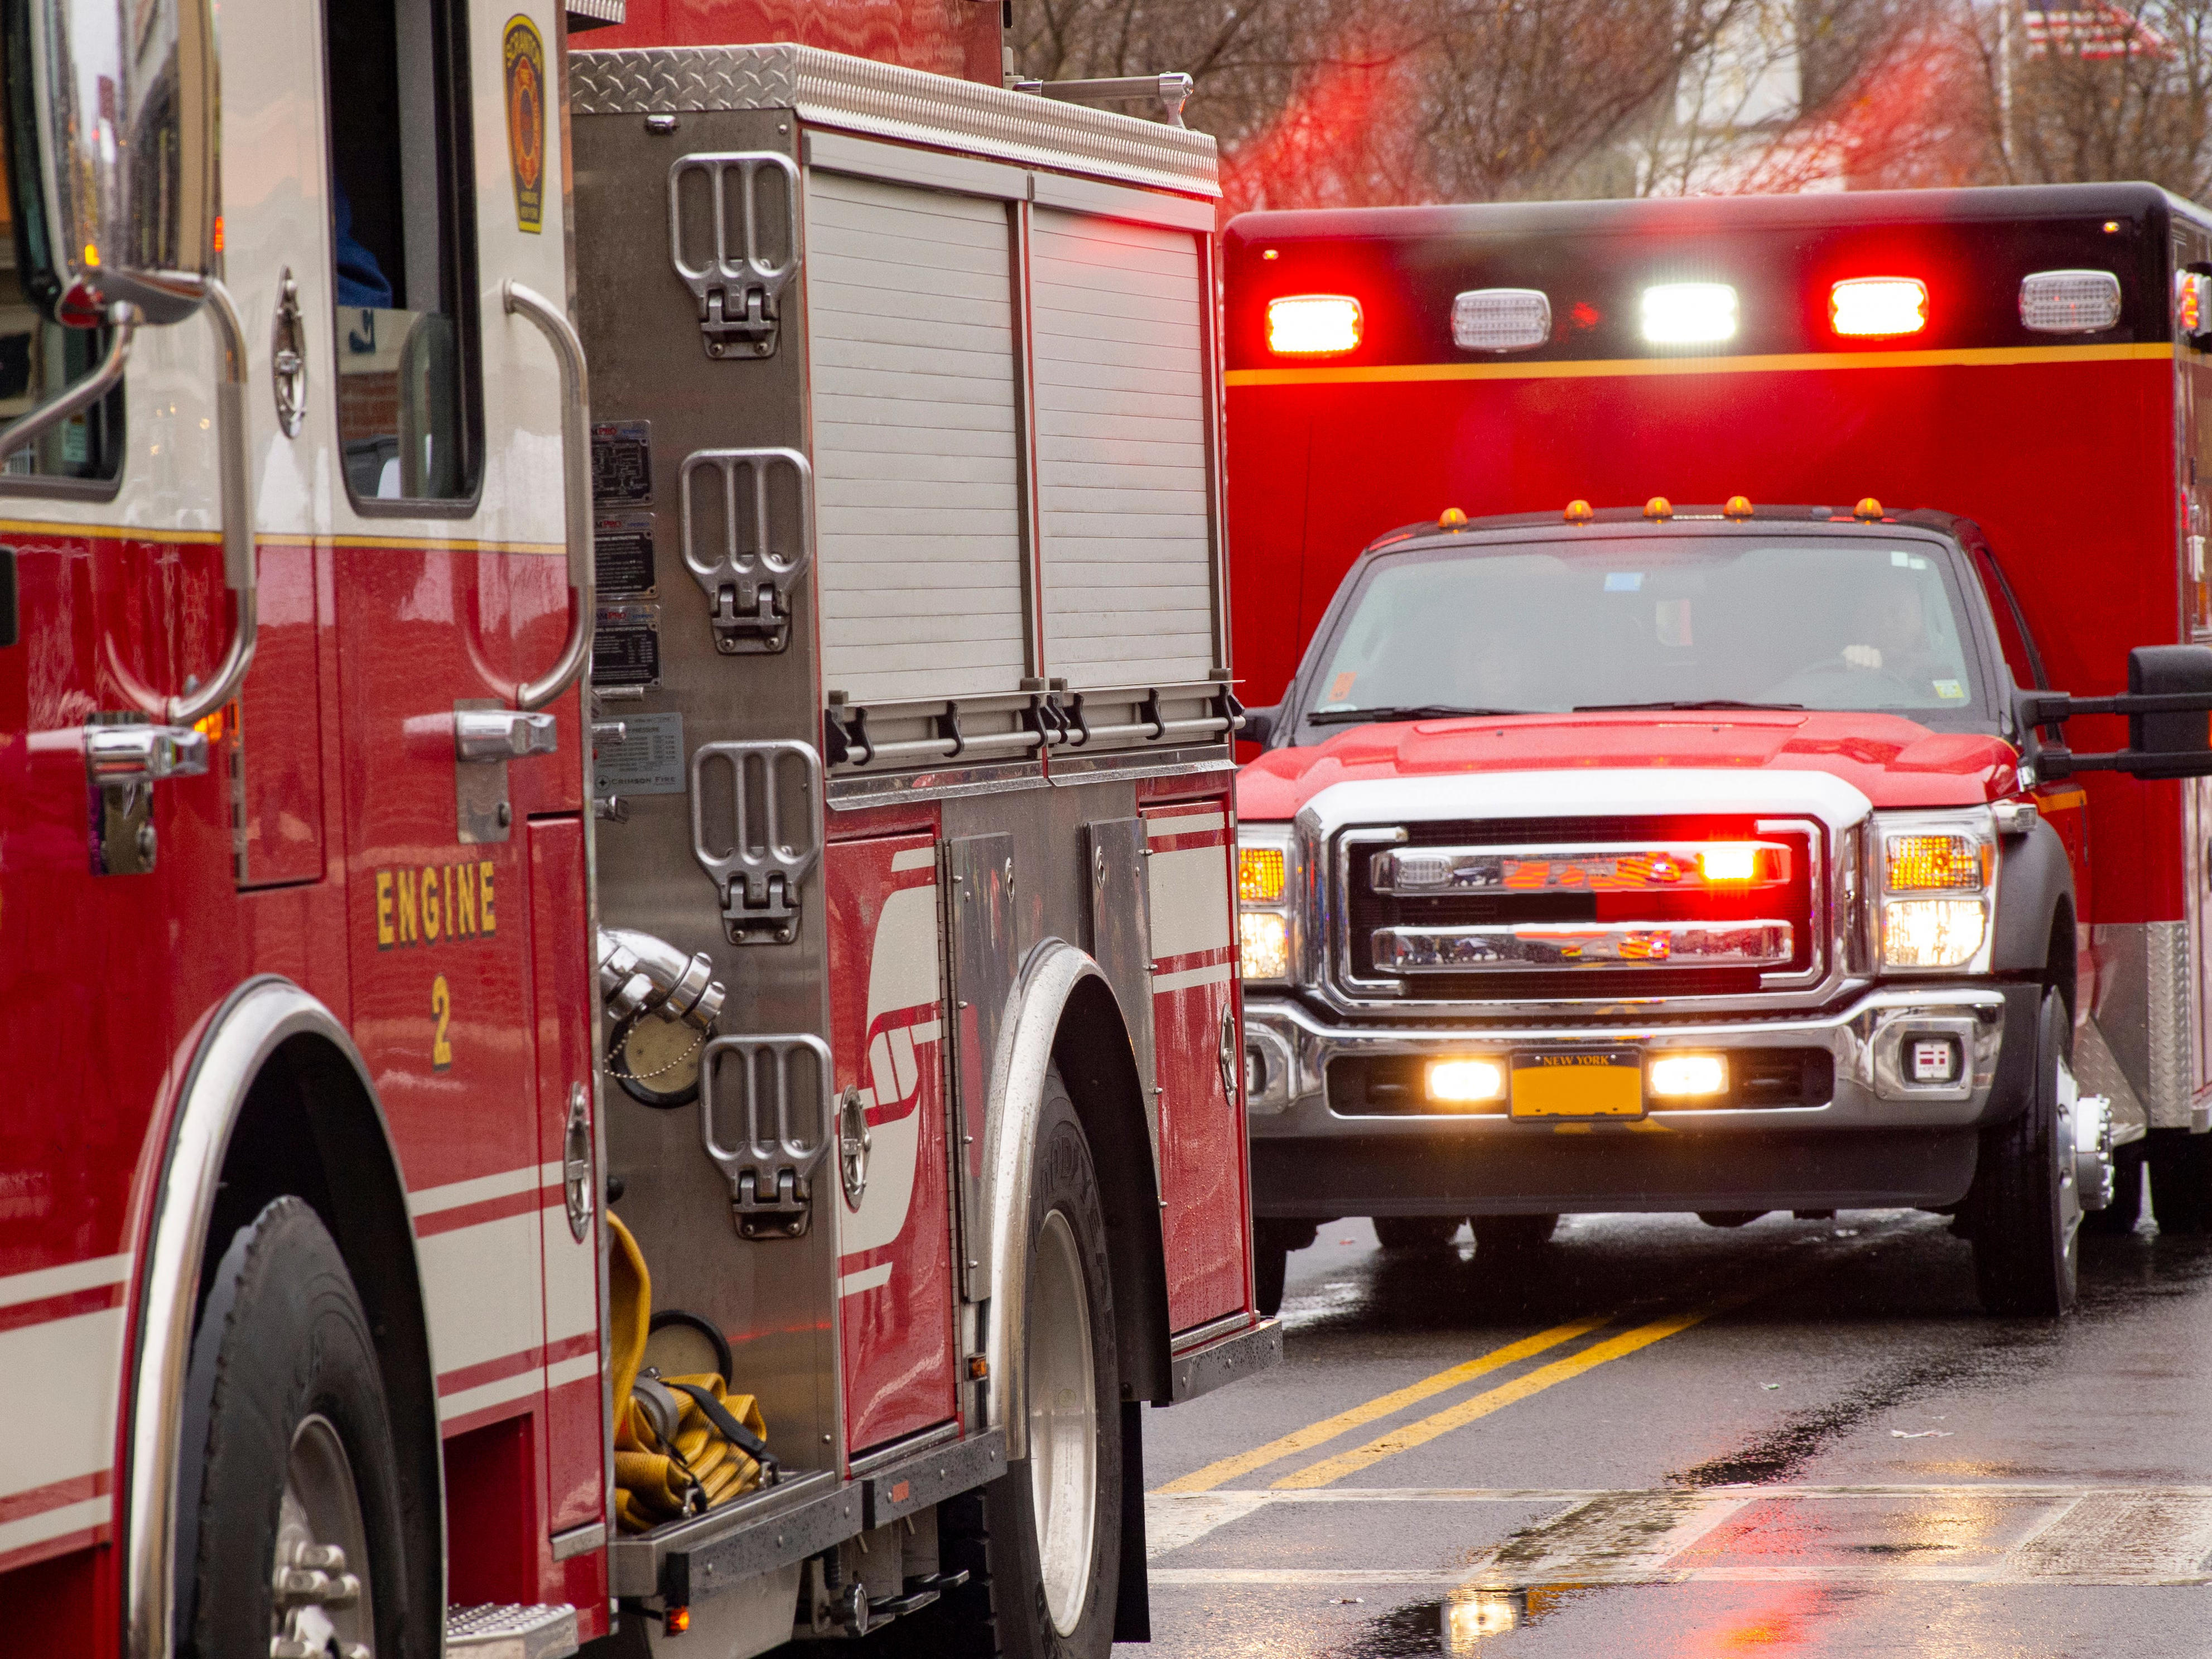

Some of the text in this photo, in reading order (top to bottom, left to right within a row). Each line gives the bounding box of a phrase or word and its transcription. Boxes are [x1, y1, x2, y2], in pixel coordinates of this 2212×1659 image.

[376, 860, 496, 952] ENGINE
[431, 973, 452, 1072] 2
[1543, 1054, 1609, 1065] NEW YORK
